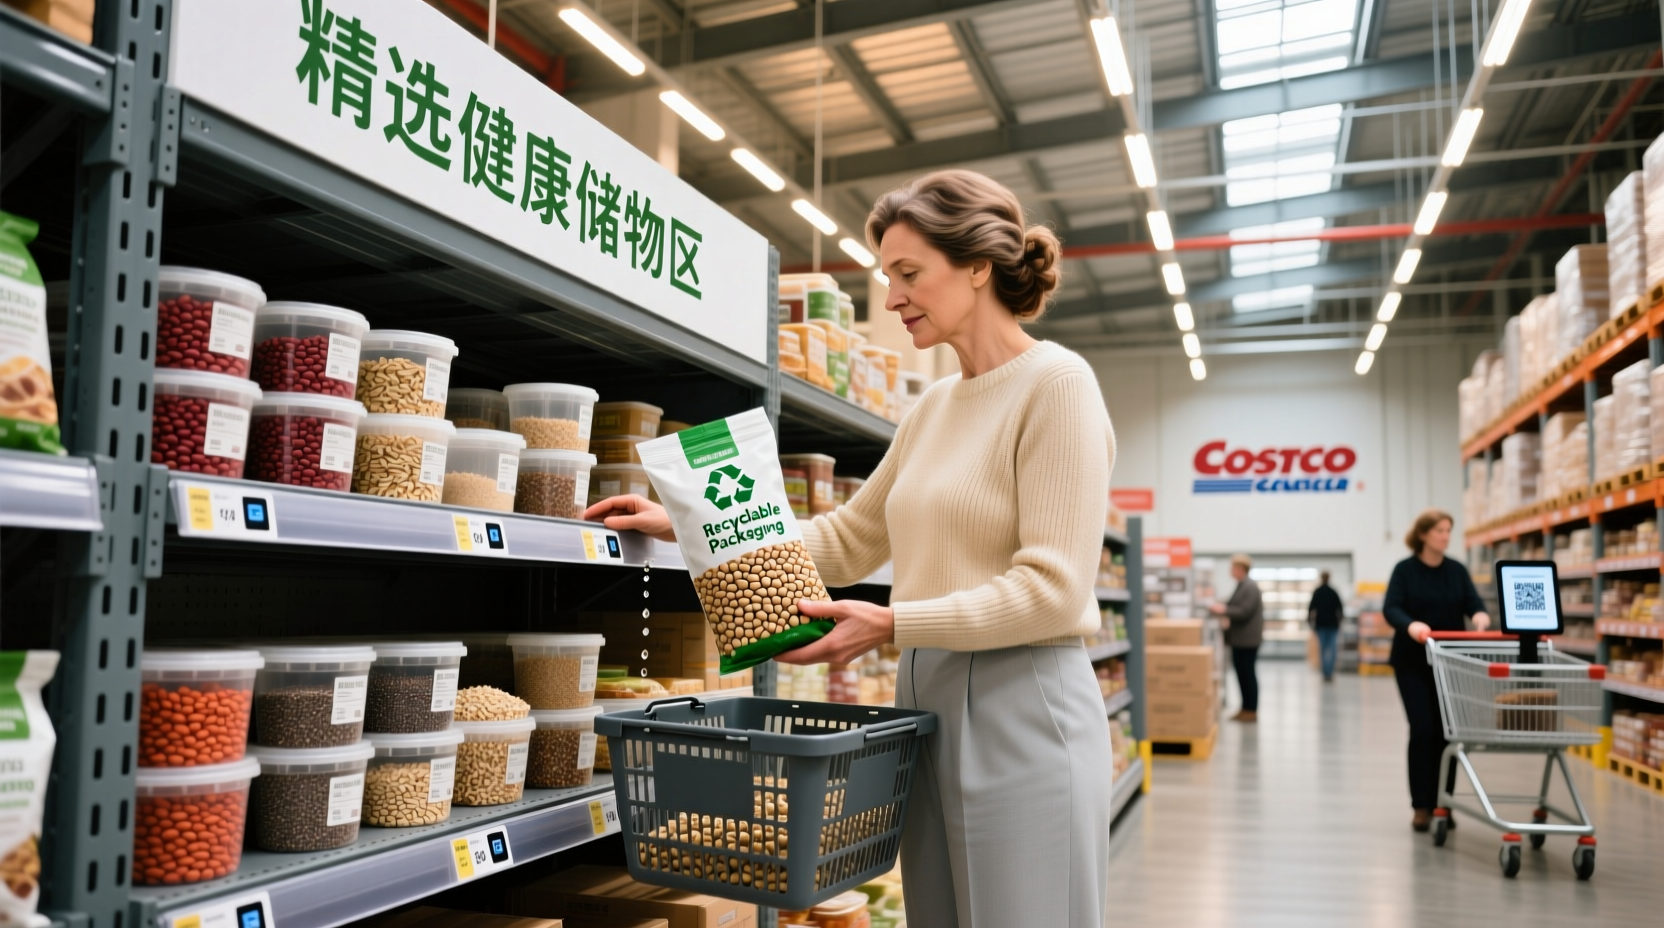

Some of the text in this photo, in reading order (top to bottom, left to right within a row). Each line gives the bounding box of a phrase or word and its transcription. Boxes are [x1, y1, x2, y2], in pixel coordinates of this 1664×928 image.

[296, 0, 703, 300] 精选健康储物区
